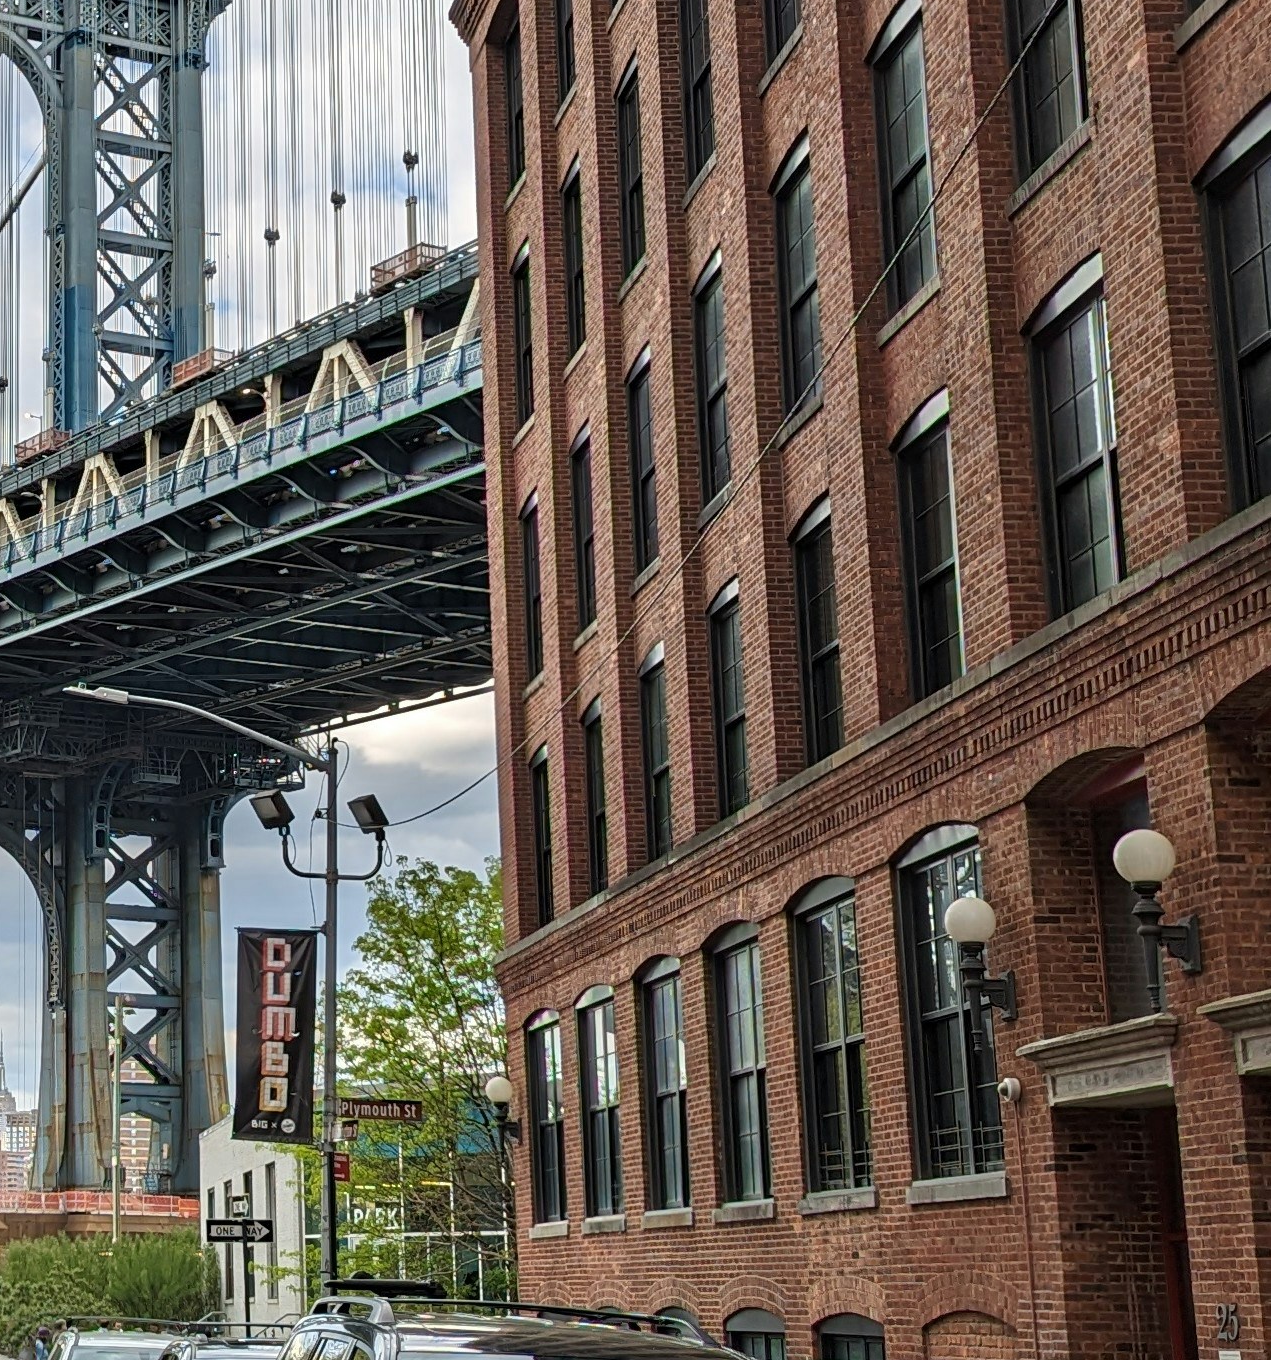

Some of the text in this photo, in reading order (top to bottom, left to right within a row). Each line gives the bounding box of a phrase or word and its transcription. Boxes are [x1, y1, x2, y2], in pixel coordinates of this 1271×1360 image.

[258, 937, 297, 1113] DUMBO
[341, 1101, 417, 1119] Plymouth St
[251, 1119, 268, 1129] BIG
[215, 1226, 235, 1236] ONE
[1216, 1302, 1239, 1342] 25
